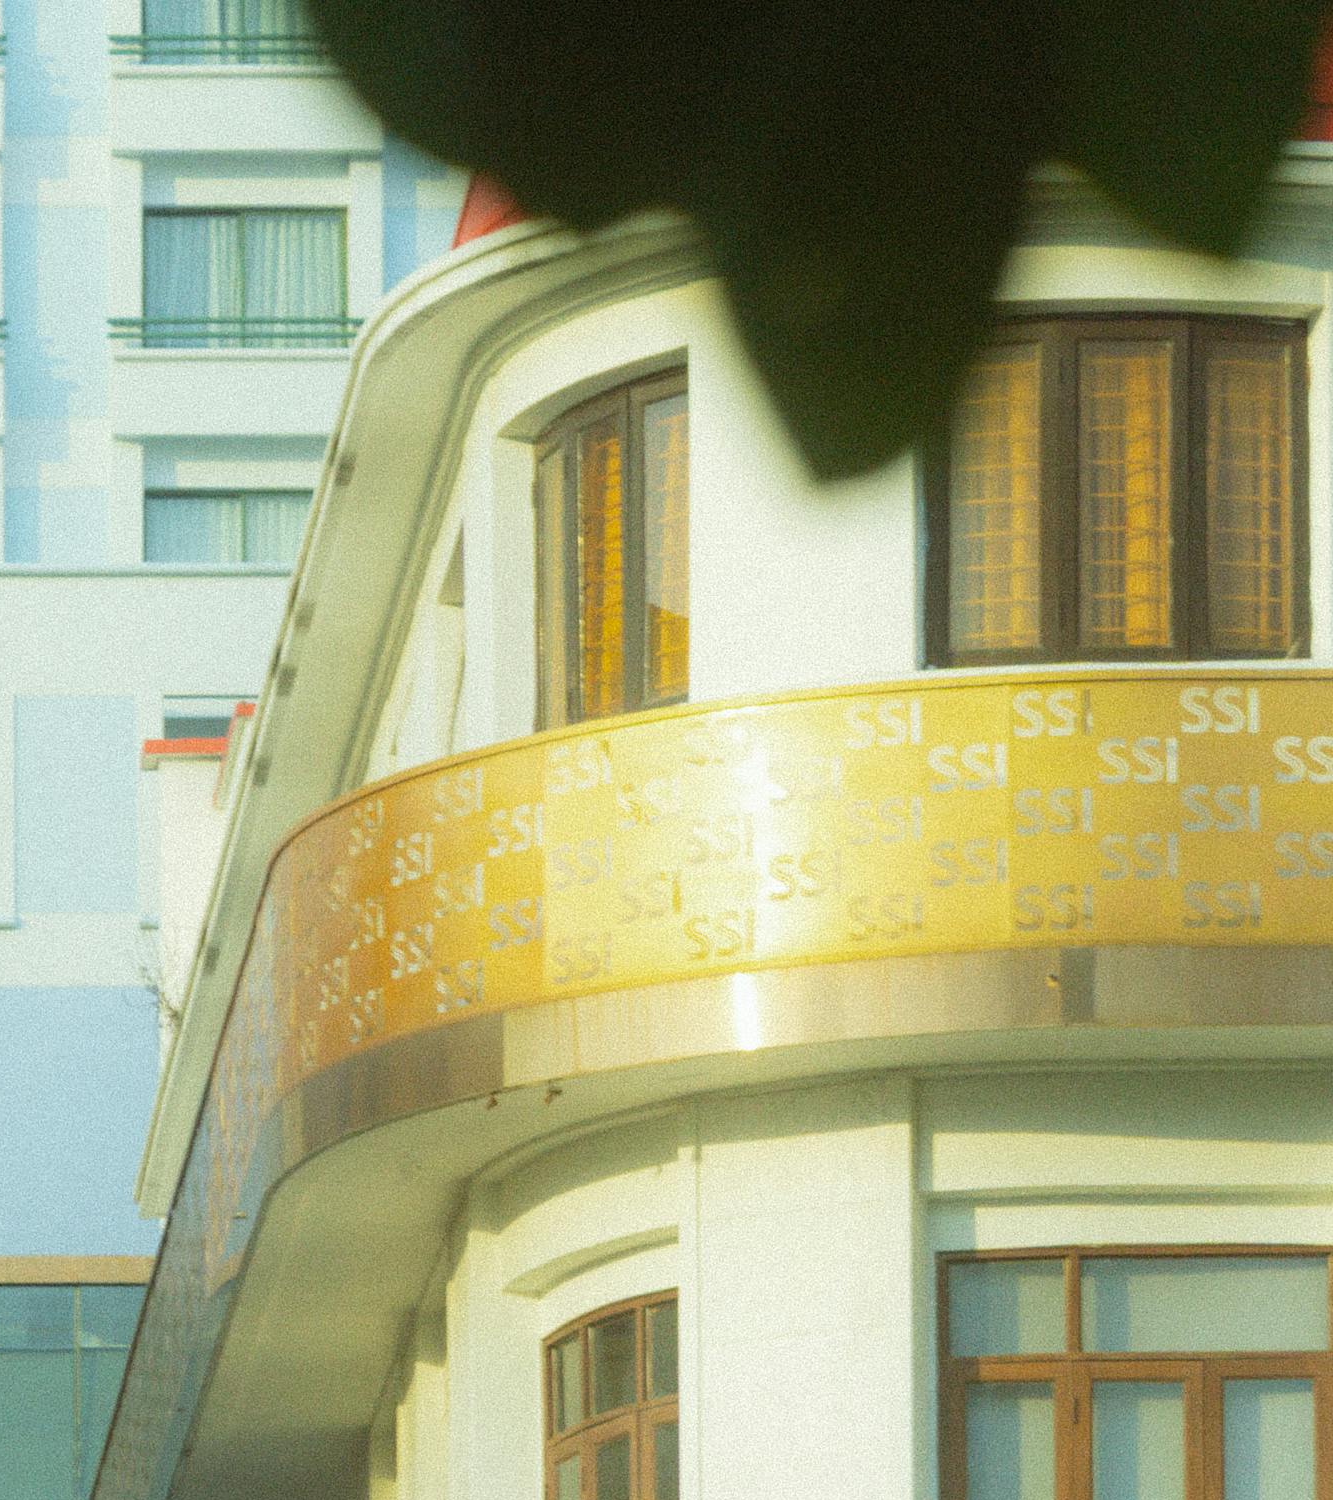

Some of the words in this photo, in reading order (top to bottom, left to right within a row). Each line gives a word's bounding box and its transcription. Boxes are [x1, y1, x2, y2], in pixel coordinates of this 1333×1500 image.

[844, 699, 922, 750] SSI
[1012, 689, 1093, 738] SSI
[1179, 687, 1260, 734] SSI
[928, 743, 1007, 790] SSI
[1097, 737, 1179, 785] SSI
[1273, 736, 1333, 784] SS
[488, 804, 544, 858] SSI
[846, 796, 922, 846] SSI
[1014, 787, 1093, 835] SSI
[1181, 784, 1260, 832] SSI
[551, 836, 613, 890] SSI
[930, 839, 1008, 886] SSI
[1098, 832, 1179, 880] SSI
[1274, 832, 1333, 878] SS
[489, 897, 544, 950] SSI
[1014, 884, 1093, 932] SSI
[1181, 881, 1261, 929] SSI
[553, 931, 613, 984] SSI
[686, 908, 754, 960] SSI
